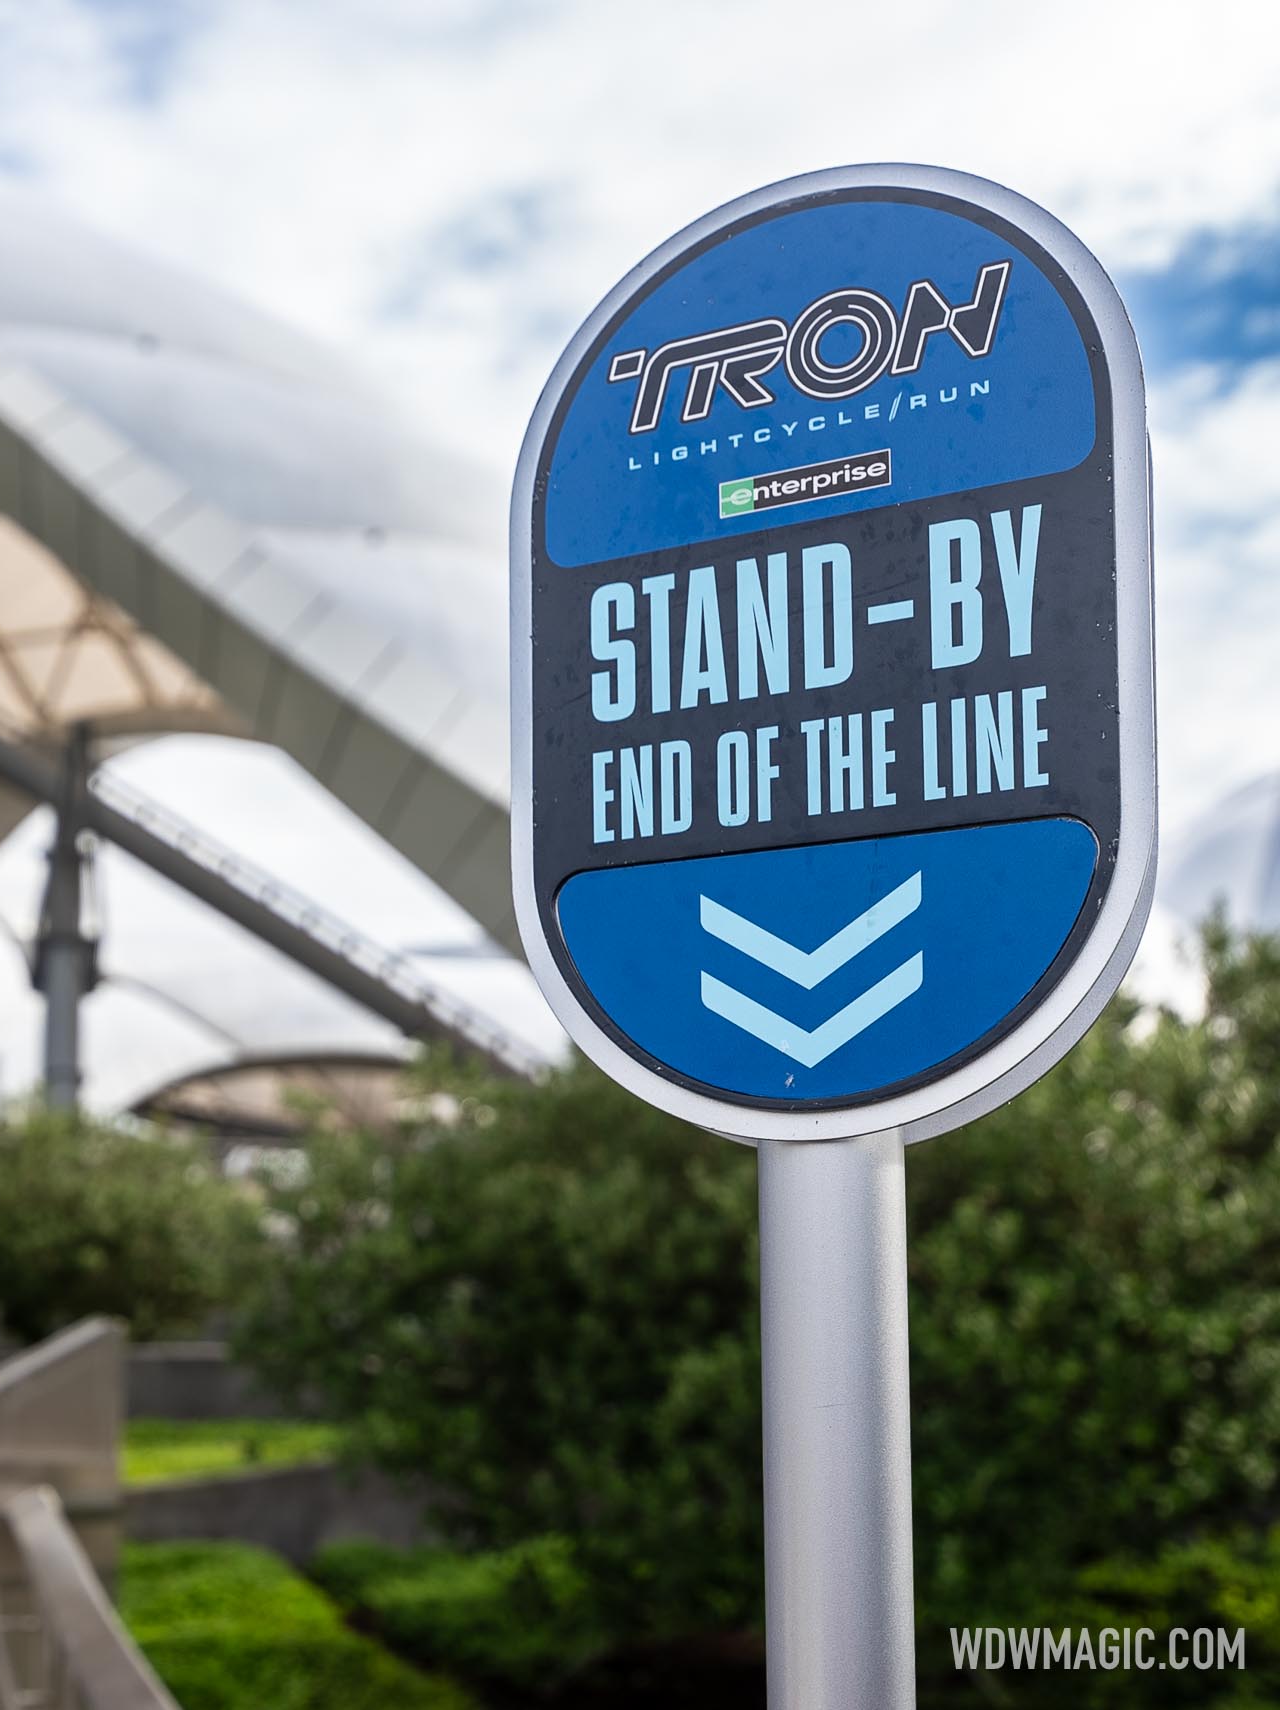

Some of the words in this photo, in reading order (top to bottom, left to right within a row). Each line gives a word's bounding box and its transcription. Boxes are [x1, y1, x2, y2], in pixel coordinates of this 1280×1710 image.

[609, 260, 1010, 433] TRON
[730, 459, 888, 506] enterprise
[590, 504, 1042, 722] STAND-BY
[592, 740, 693, 843] END
[718, 725, 780, 827] OF
[802, 708, 896, 816] THE
[922, 686, 1049, 801] LINE
